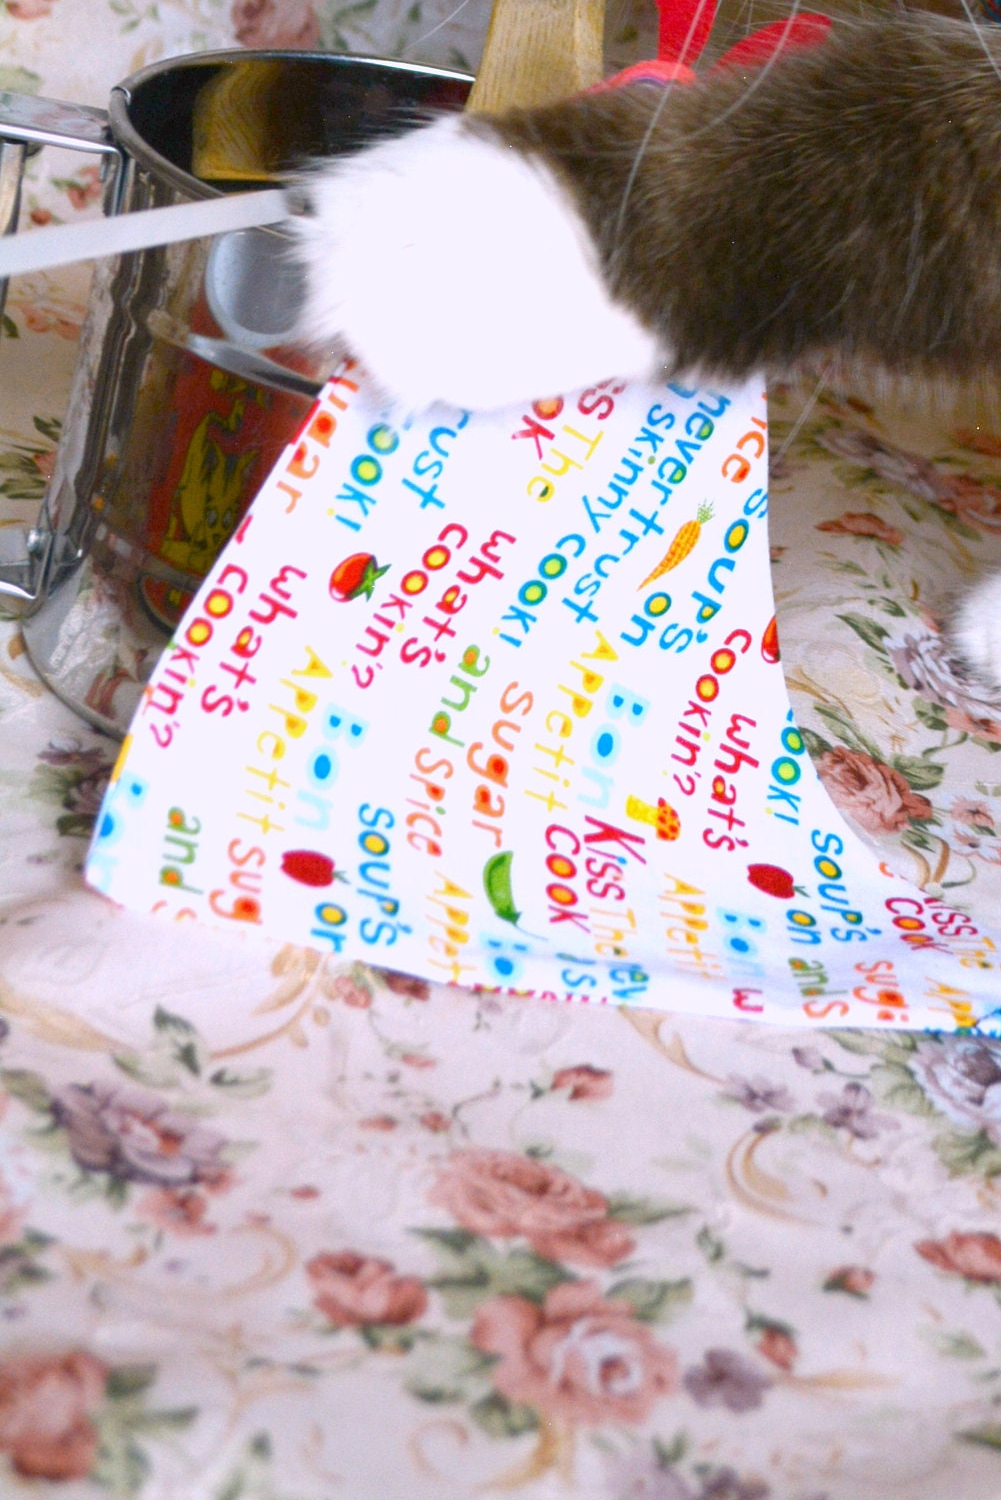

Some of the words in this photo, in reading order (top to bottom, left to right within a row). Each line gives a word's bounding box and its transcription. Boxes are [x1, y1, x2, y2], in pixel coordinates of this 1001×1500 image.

[326, 415, 402, 532] ook!
[526, 424, 604, 503] The
[581, 403, 676, 534] skinny
[656, 388, 732, 506] never
[399, 529, 517, 668] what's
[560, 507, 665, 624] trust
[620, 591, 672, 647] on
[200, 564, 308, 718] what's
[427, 643, 491, 748] and
[235, 643, 335, 836] Appetit
[294, 700, 371, 832] Bon
[523, 628, 620, 814] Appetit
[576, 682, 651, 810] Bon
[701, 713, 760, 853] what's
[158, 805, 204, 896] and
[583, 814, 648, 902] Kiss
[588, 906, 638, 959] The
[715, 906, 768, 979] Bon
[785, 908, 823, 946] on
[787, 956, 849, 997] and
